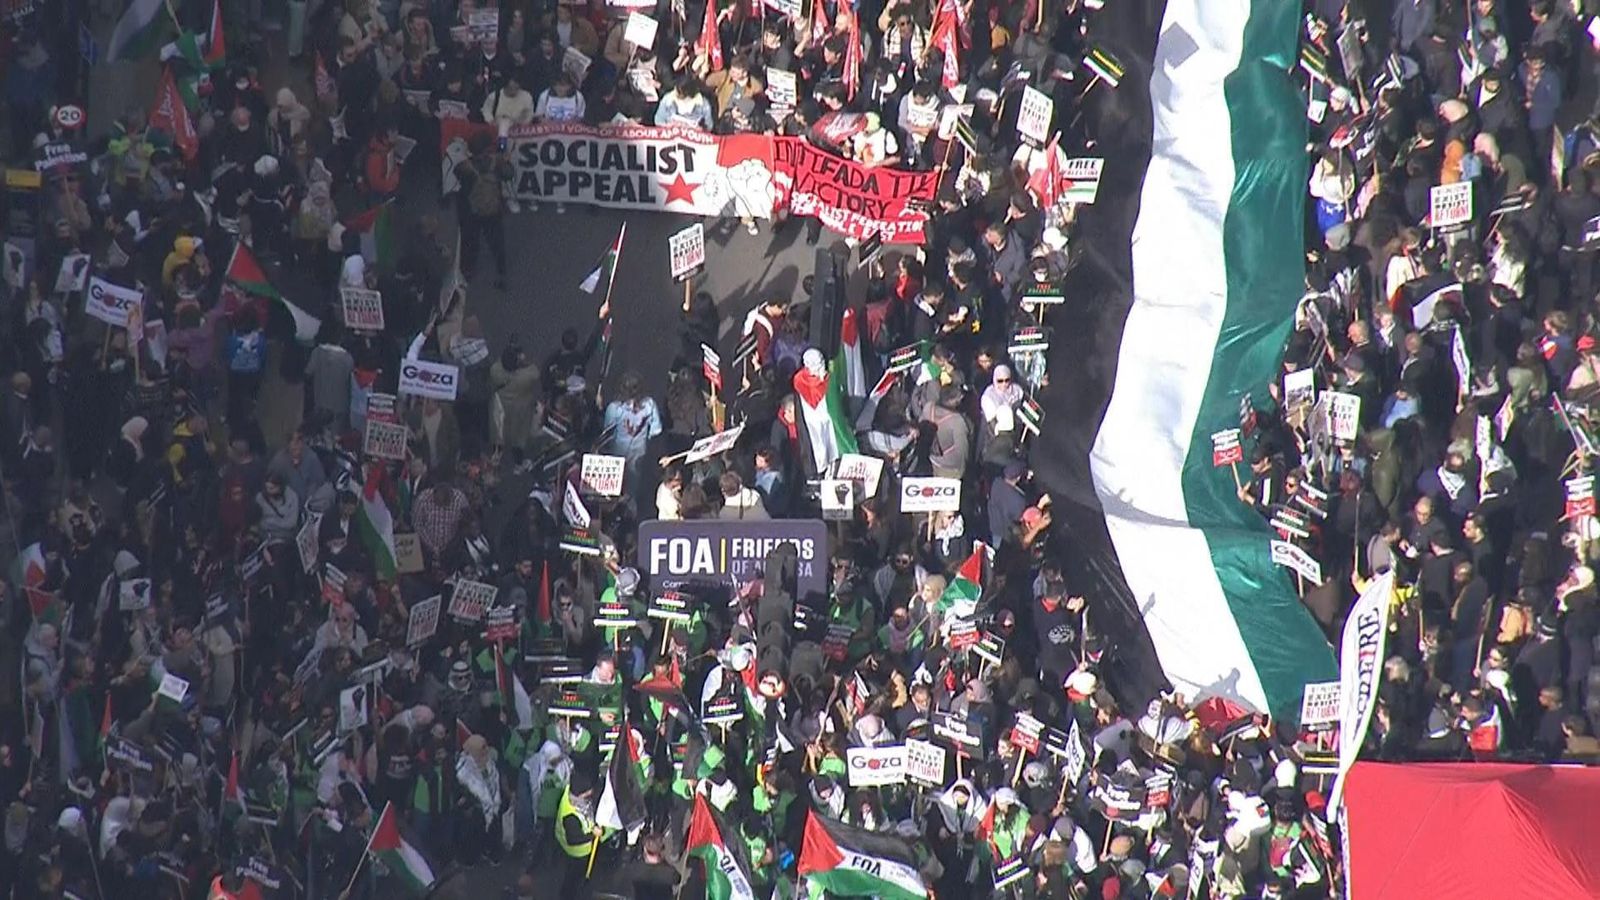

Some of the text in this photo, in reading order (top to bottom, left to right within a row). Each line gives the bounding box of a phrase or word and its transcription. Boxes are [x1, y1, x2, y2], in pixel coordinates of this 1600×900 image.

[60, 110, 81, 121] 20
[615, 128, 659, 139] LABOUR
[660, 127, 680, 139] AND
[681, 127, 713, 144] YOUTH
[518, 139, 696, 175] SOCIALIST
[1069, 160, 1097, 169] FREE
[517, 171, 657, 204] APPEAL
[793, 173, 891, 219] VICTORY
[403, 365, 453, 386] Gaza
[905, 484, 956, 498] Gaza
[650, 537, 715, 575] FOA
[732, 561, 749, 574] OF
[851, 755, 902, 770] Gaza
[852, 855, 881, 877] FOA
